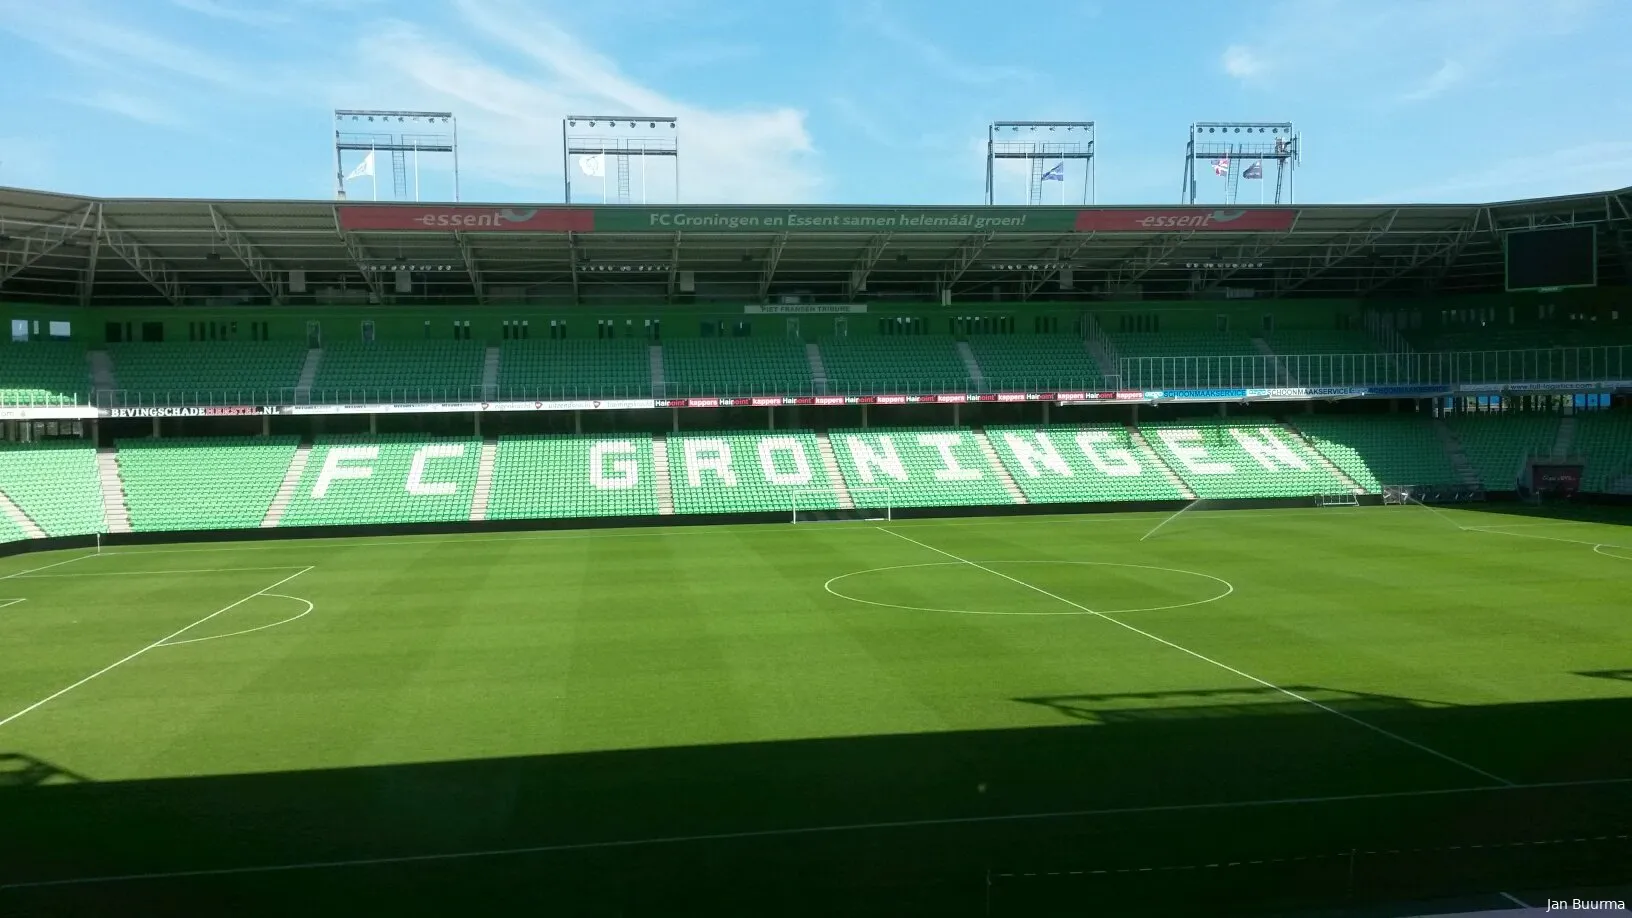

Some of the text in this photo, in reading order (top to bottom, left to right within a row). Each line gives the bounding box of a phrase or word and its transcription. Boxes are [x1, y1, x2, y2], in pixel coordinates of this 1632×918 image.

[421, 212, 503, 226] essent
[650, 213, 1026, 228] FC Groningen en Essent samen helemáál groen!
[1140, 213, 1212, 227] essent
[938, 395, 965, 403] kappers
[998, 394, 1026, 402] kappers
[1057, 393, 1084, 401] kappers
[1116, 391, 1143, 399] kappers
[689, 399, 718, 407] kappers
[752, 397, 781, 406] kappers
[815, 397, 844, 405] kappers
[877, 396, 905, 404] kappers
[311, 427, 1313, 499] FC GRONINGEN
